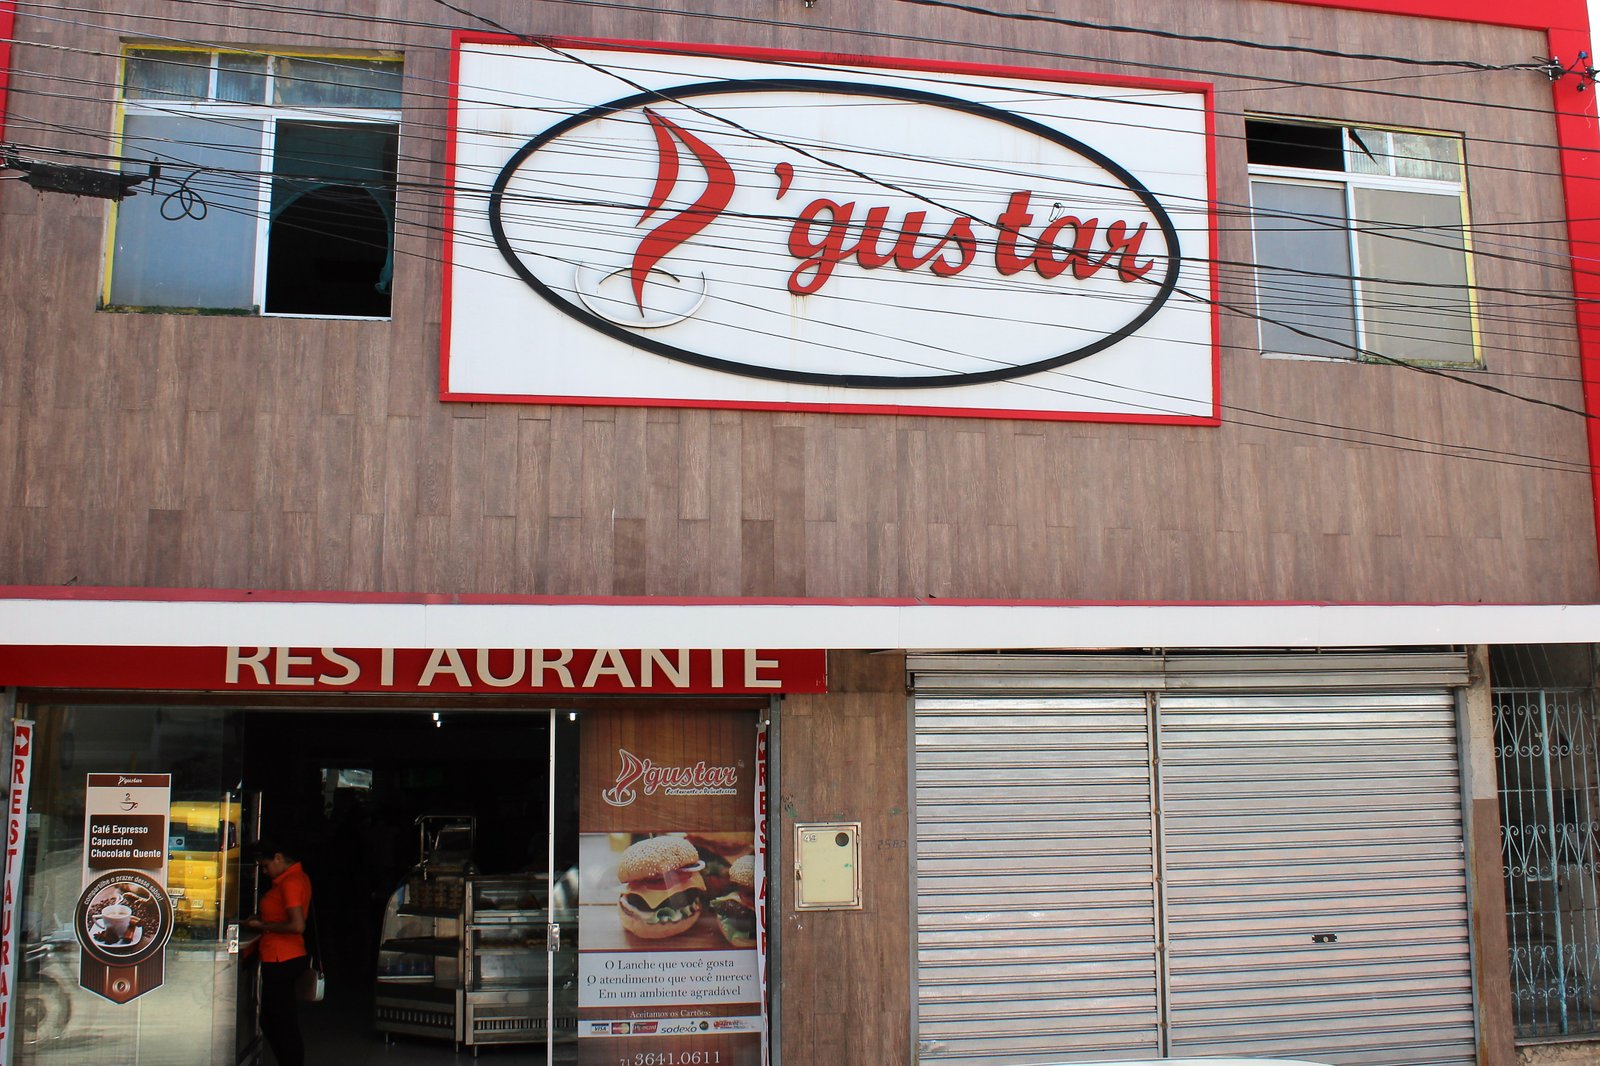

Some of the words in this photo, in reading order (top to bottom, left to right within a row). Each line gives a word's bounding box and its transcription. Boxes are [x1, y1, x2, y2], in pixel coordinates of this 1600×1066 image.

[225, 646, 782, 688] RESTAURANTE
[92, 825, 110, 834] Café
[112, 825, 148, 835] Expresso
[91, 837, 133, 847] Capuccino
[91, 849, 131, 858] Chocolate
[133, 849, 161, 858] Quente
[135, 876, 150, 887] desse
[605, 960, 615, 970] O
[618, 959, 656, 970] Lanche
[658, 960, 677, 971] que
[680, 958, 704, 968] você
[706, 960, 734, 971] gosta
[587, 974, 597, 985] O
[600, 973, 665, 984] atendimento
[668, 975, 687, 985] que
[689, 972, 713, 982] você
[715, 973, 752, 982] merece
[599, 989, 617, 999] Em
[620, 990, 637, 999] um
[639, 988, 688, 998] ambiente
[690, 985, 741, 999] agradável
[630, 1010, 669, 1018] Aceitamos
[680, 1009, 711, 1017] Cartões:
[661, 1023, 697, 1034] sodexo
[634, 1051, 720, 1066] 3641.0611
